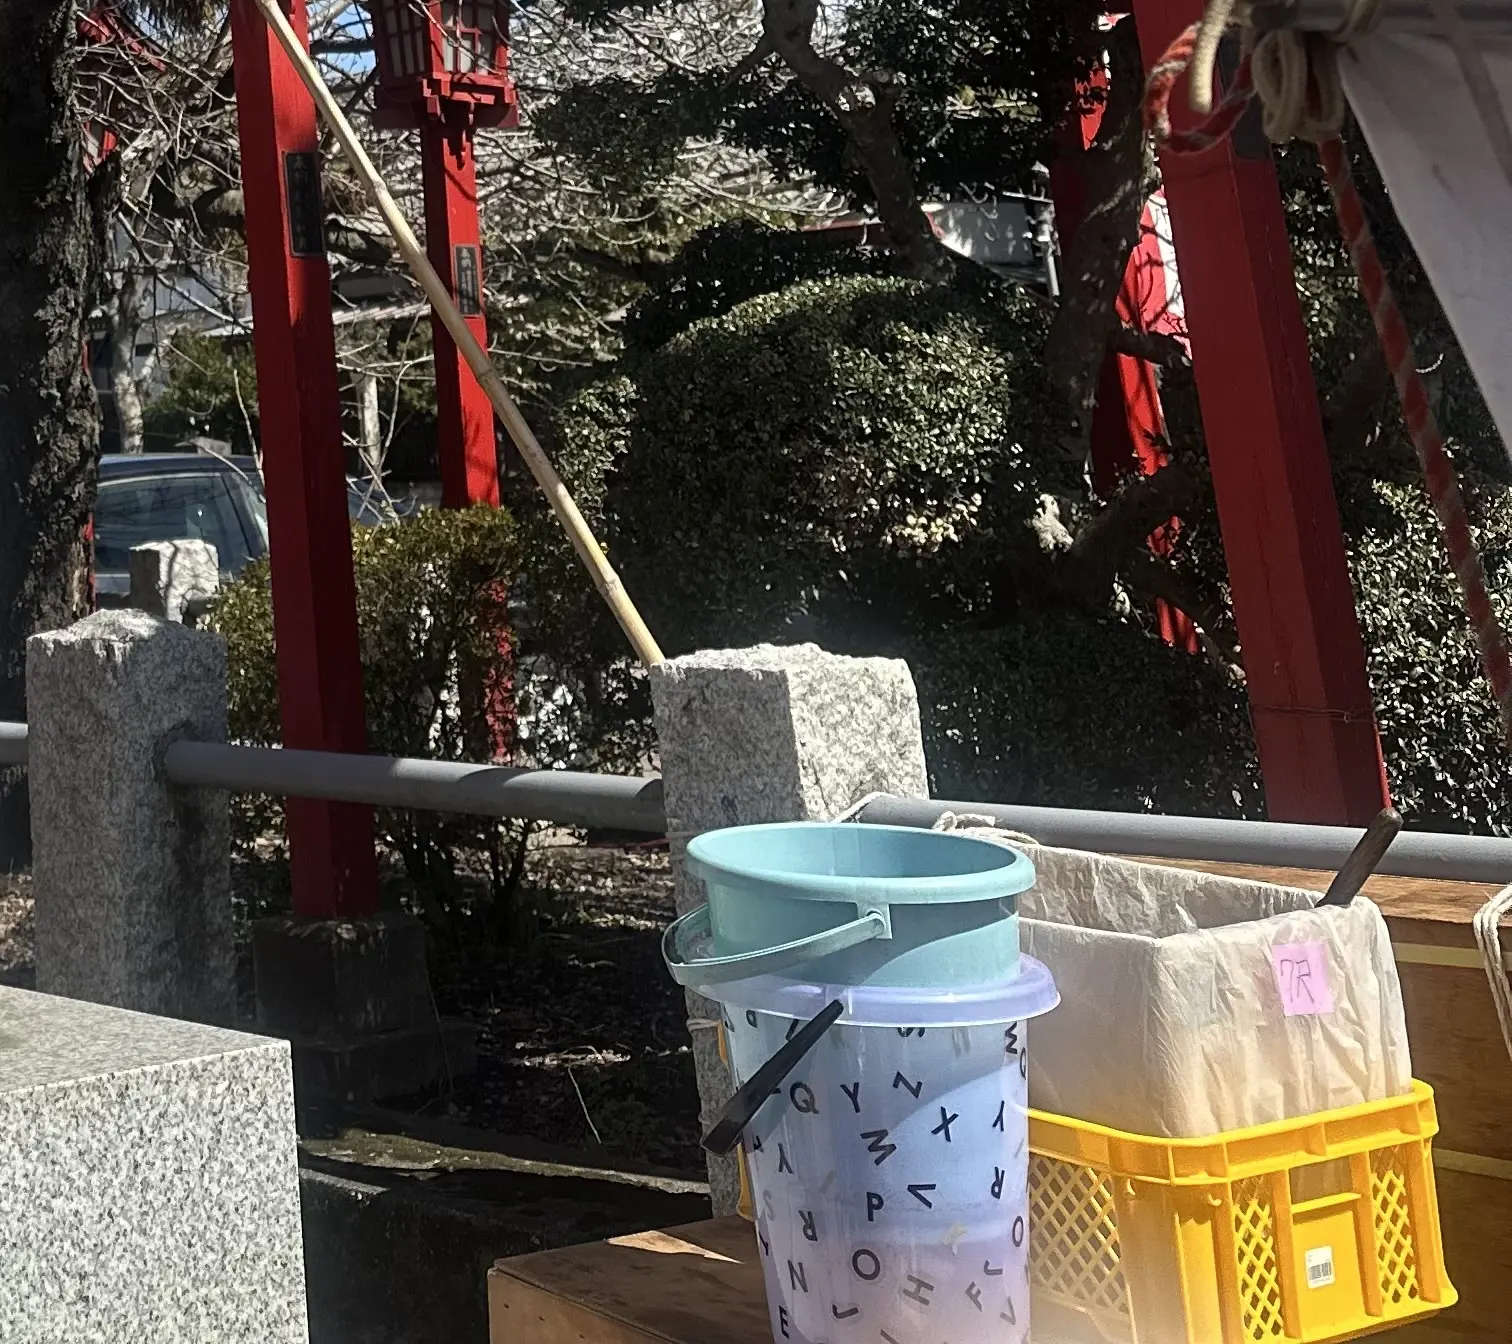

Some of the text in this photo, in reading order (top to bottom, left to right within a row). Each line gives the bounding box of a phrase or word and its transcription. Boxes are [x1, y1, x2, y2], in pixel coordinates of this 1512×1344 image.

[789, 1081, 820, 1114] Q
[840, 1082, 861, 1113] Y
[931, 1106, 959, 1142] X
[991, 1166, 1005, 1199] R
[866, 1191, 885, 1222] P
[798, 1210, 818, 1242] R
[787, 1259, 809, 1293] N
[851, 1248, 881, 1281] O
